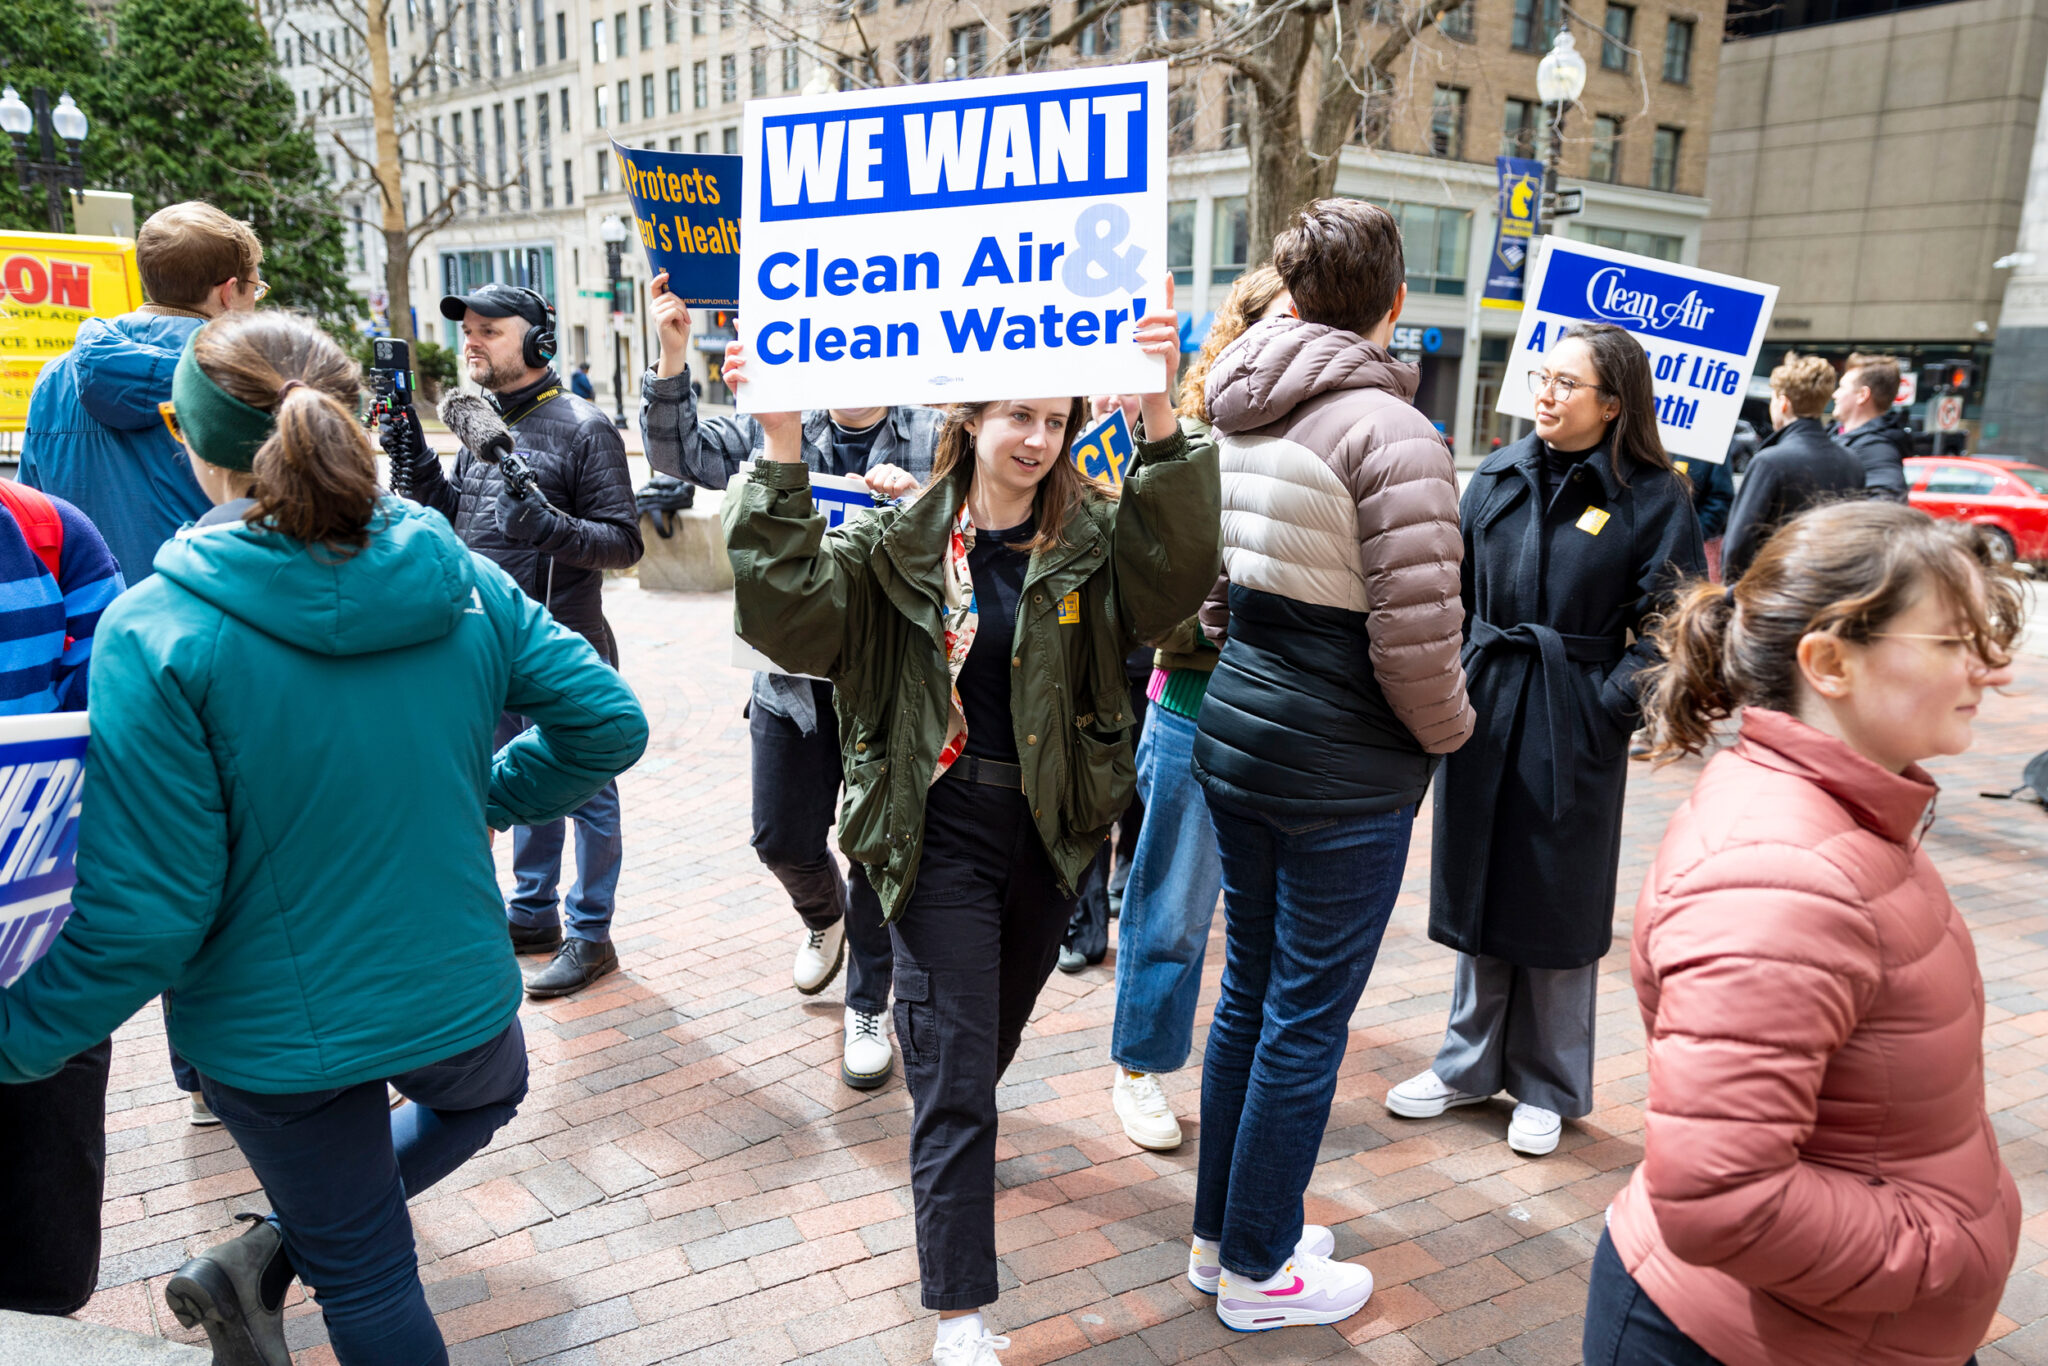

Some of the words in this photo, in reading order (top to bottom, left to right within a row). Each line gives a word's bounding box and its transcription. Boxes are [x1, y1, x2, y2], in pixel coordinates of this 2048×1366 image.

[766, 117, 884, 207] WE
[903, 93, 1142, 196] WANT
[626, 158, 721, 205] Protects
[636, 213, 673, 252] en's
[674, 215, 741, 254] Healt
[757, 249, 940, 301] Clean
[962, 232, 1065, 287] Air
[1061, 203, 1148, 299] &
[0, 256, 91, 308] ON
[1586, 267, 1658, 330] Clean
[1650, 289, 1715, 331] Air
[757, 318, 920, 366] Clean
[940, 298, 1147, 354] Water!
[1389, 327, 1422, 350] SE
[1526, 320, 1547, 353] A
[1654, 353, 1688, 383] of
[1688, 356, 1741, 396] Life
